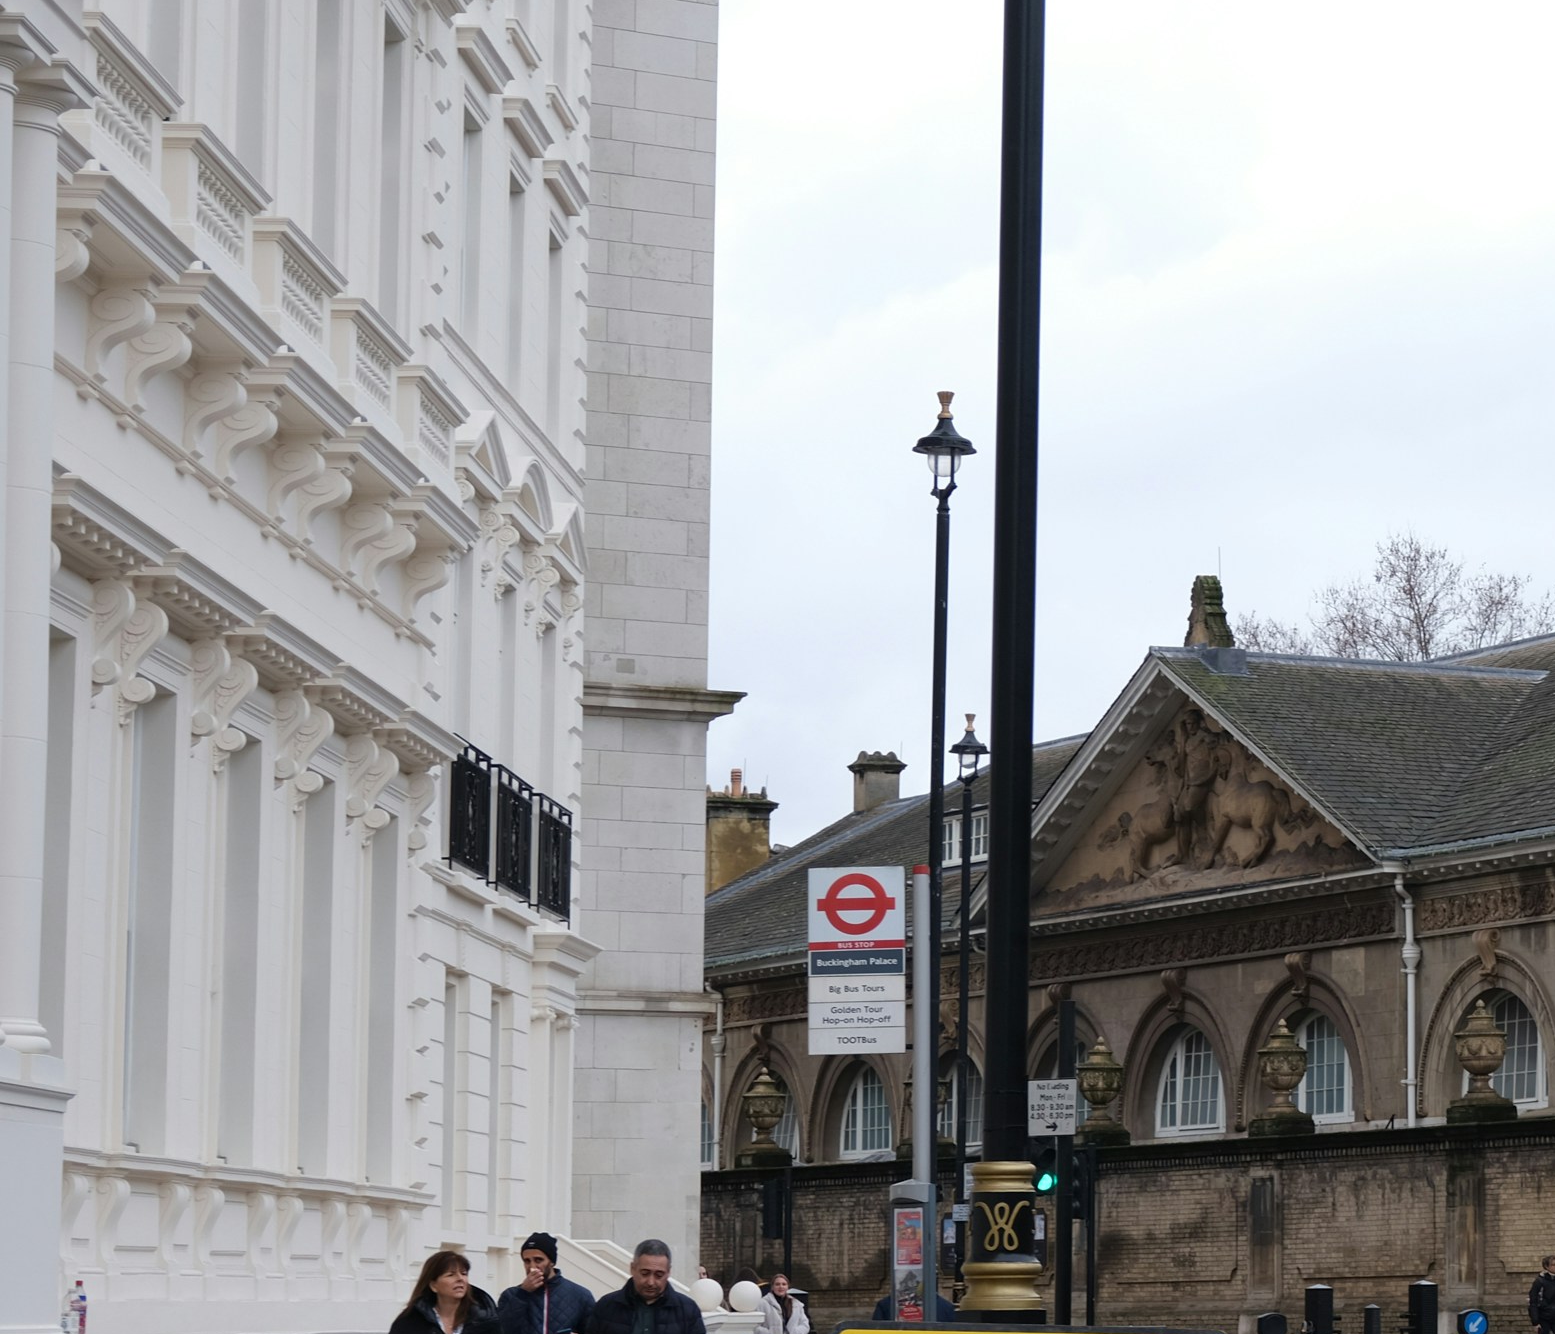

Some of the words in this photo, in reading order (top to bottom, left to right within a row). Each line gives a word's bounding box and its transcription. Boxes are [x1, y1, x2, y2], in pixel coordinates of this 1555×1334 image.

[816, 958, 867, 968] Buckingham
[869, 957, 898, 965] Palace
[829, 985, 841, 994] Big
[844, 985, 859, 993] Bus
[830, 1006, 861, 1014] Golden
[864, 1005, 884, 1013] Tour
[822, 1016, 855, 1025] Hop-on
[857, 1015, 891, 1024] Hop-off
[837, 1036, 877, 1044] TOOTBus
